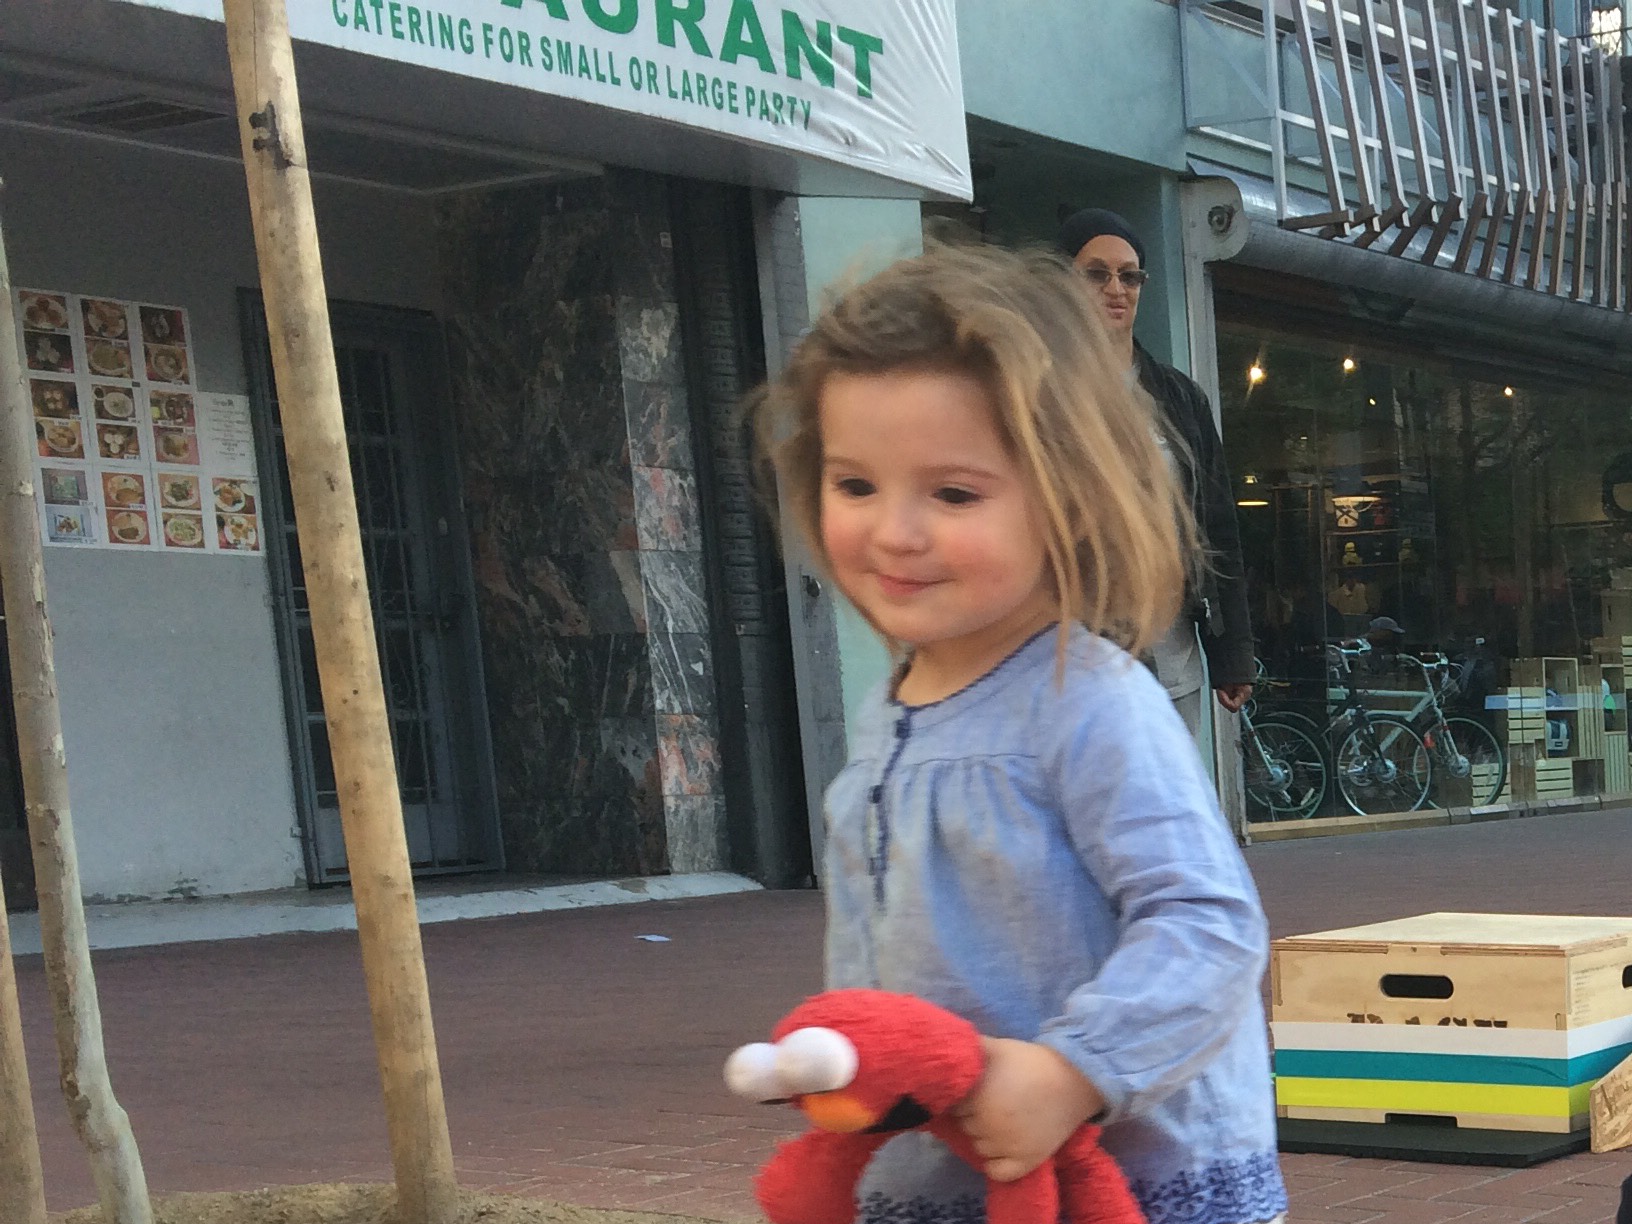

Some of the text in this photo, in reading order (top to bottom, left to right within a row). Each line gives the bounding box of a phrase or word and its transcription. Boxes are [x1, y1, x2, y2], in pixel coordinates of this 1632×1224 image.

[332, 0, 811, 130] CATERING FOR SMALL OR LARGE PARTY
[500, 0, 884, 99] RANT
